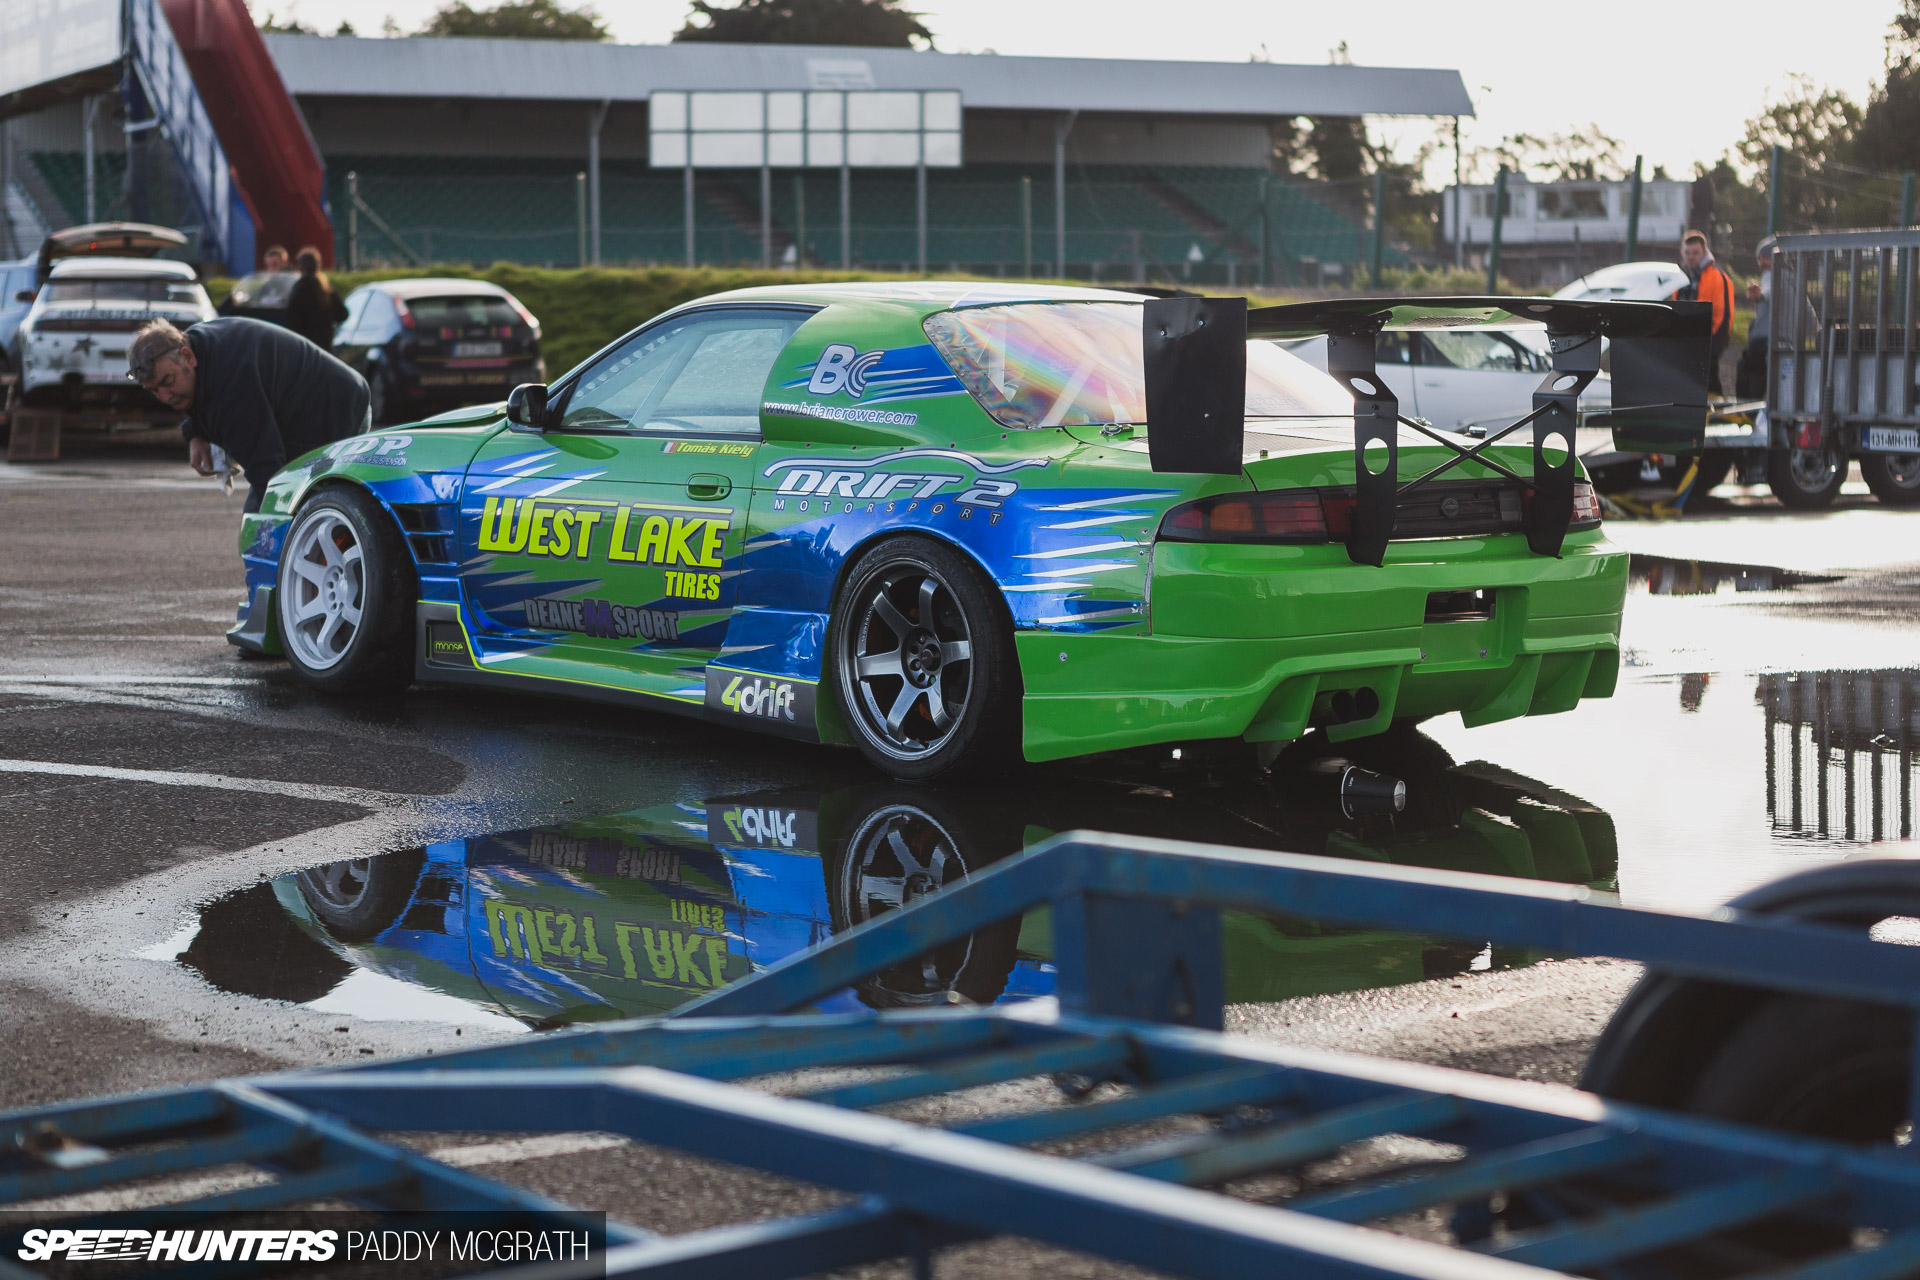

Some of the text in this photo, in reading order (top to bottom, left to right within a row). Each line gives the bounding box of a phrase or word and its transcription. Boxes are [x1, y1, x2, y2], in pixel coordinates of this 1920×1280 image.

[764, 401, 918, 426] www.briancrower.com
[676, 442, 754, 458] Tomás Kiely
[775, 469, 1018, 509] DRIFT 2
[774, 499, 1003, 525] MOTORSPORT
[477, 496, 734, 568] WEST LAKE
[664, 570, 721, 601] TIRES
[721, 675, 796, 721] 4drift
